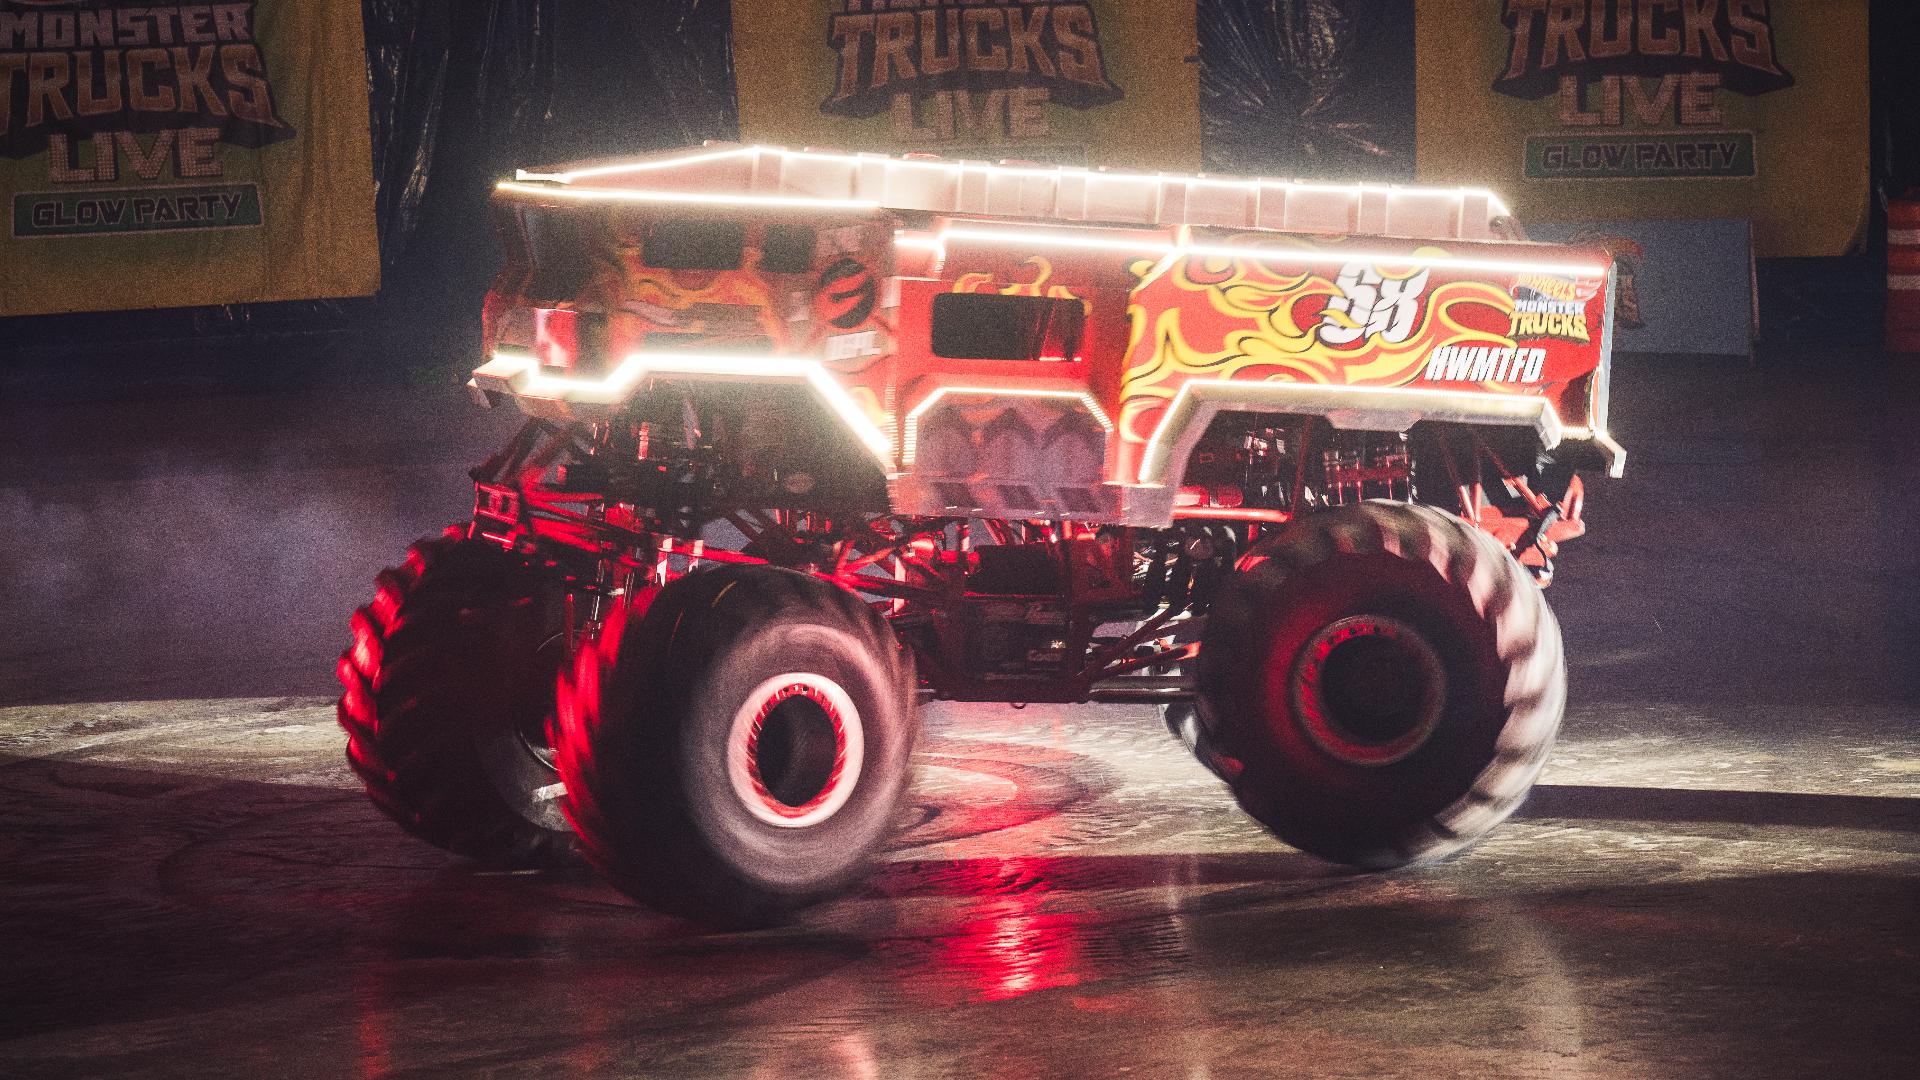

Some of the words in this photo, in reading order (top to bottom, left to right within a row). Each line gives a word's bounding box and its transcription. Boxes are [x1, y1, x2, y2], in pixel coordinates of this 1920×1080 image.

[0, 3, 251, 49] MONSTER
[1504, 0, 1783, 79] TRUCKS
[831, 4, 1112, 101] TRUCKS
[0, 44, 285, 136] TRUCKS
[891, 86, 1050, 142] LIVE
[1559, 71, 1722, 126] LIVE
[50, 127, 223, 182] LIVE
[1542, 144, 1627, 171] GLOW
[1634, 142, 1738, 169] PARTY
[32, 201, 128, 228] GLOW
[134, 192, 242, 224] PARTY
[1506, 311, 1590, 342] TRUCKS
[1514, 299, 1586, 316] MONSTER
[1424, 346, 1547, 383] HWMTFD
